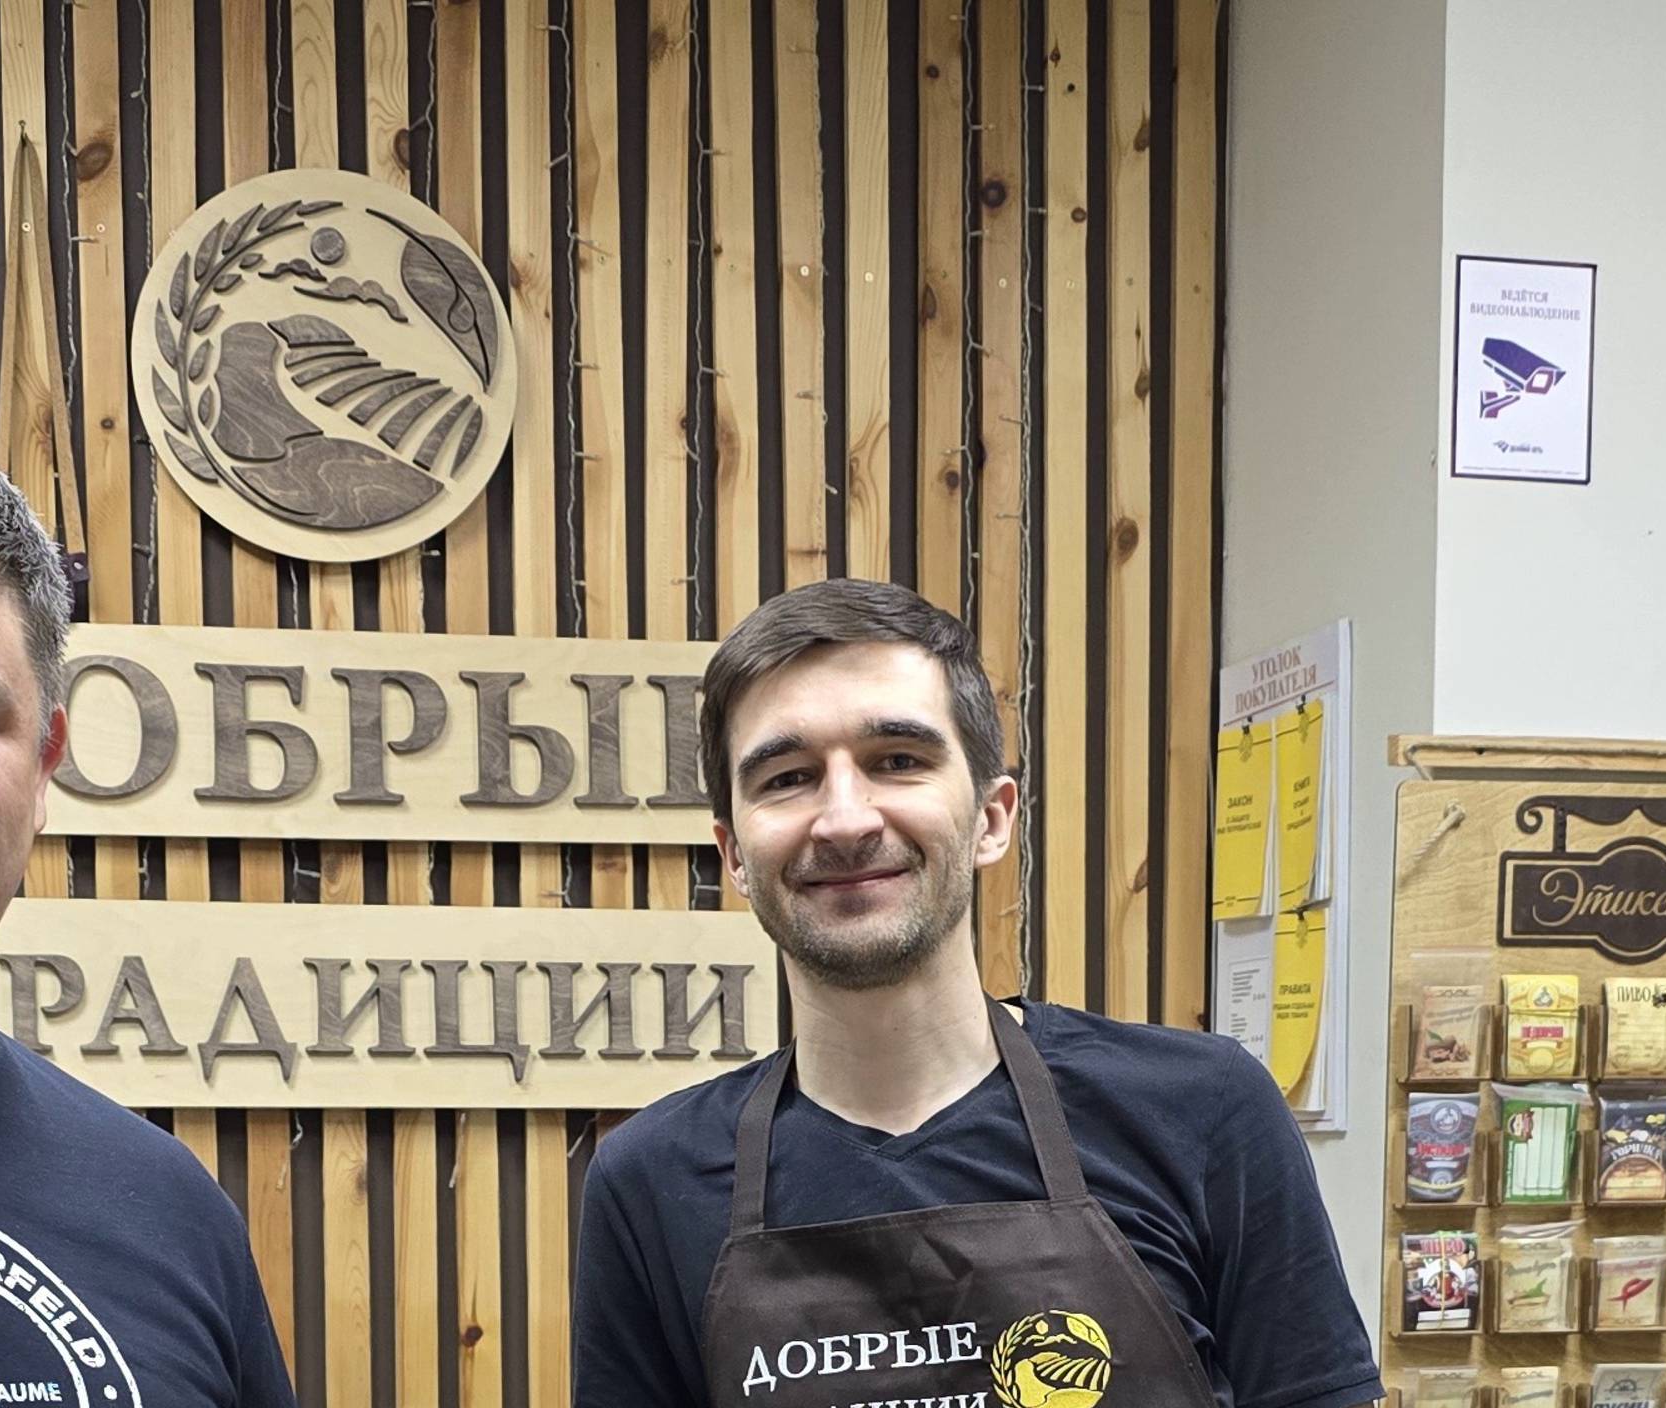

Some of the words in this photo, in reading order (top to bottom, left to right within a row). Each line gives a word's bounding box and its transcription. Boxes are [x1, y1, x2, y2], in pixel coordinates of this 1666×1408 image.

[1470, 302, 1581, 321] ВИДЕОНАБЛЮДЕНИЕ
[1501, 288, 1549, 304] ВЕДЁТСЯ
[1251, 644, 1302, 685] УГОЛОК
[1235, 663, 1318, 713] ПОКУПАТЕЛЯ
[52, 655, 712, 809] ОБРЫЕ
[1617, 985, 1651, 1003] ПИВО
[742, 1321, 983, 1397] ДОБРЫЕ
